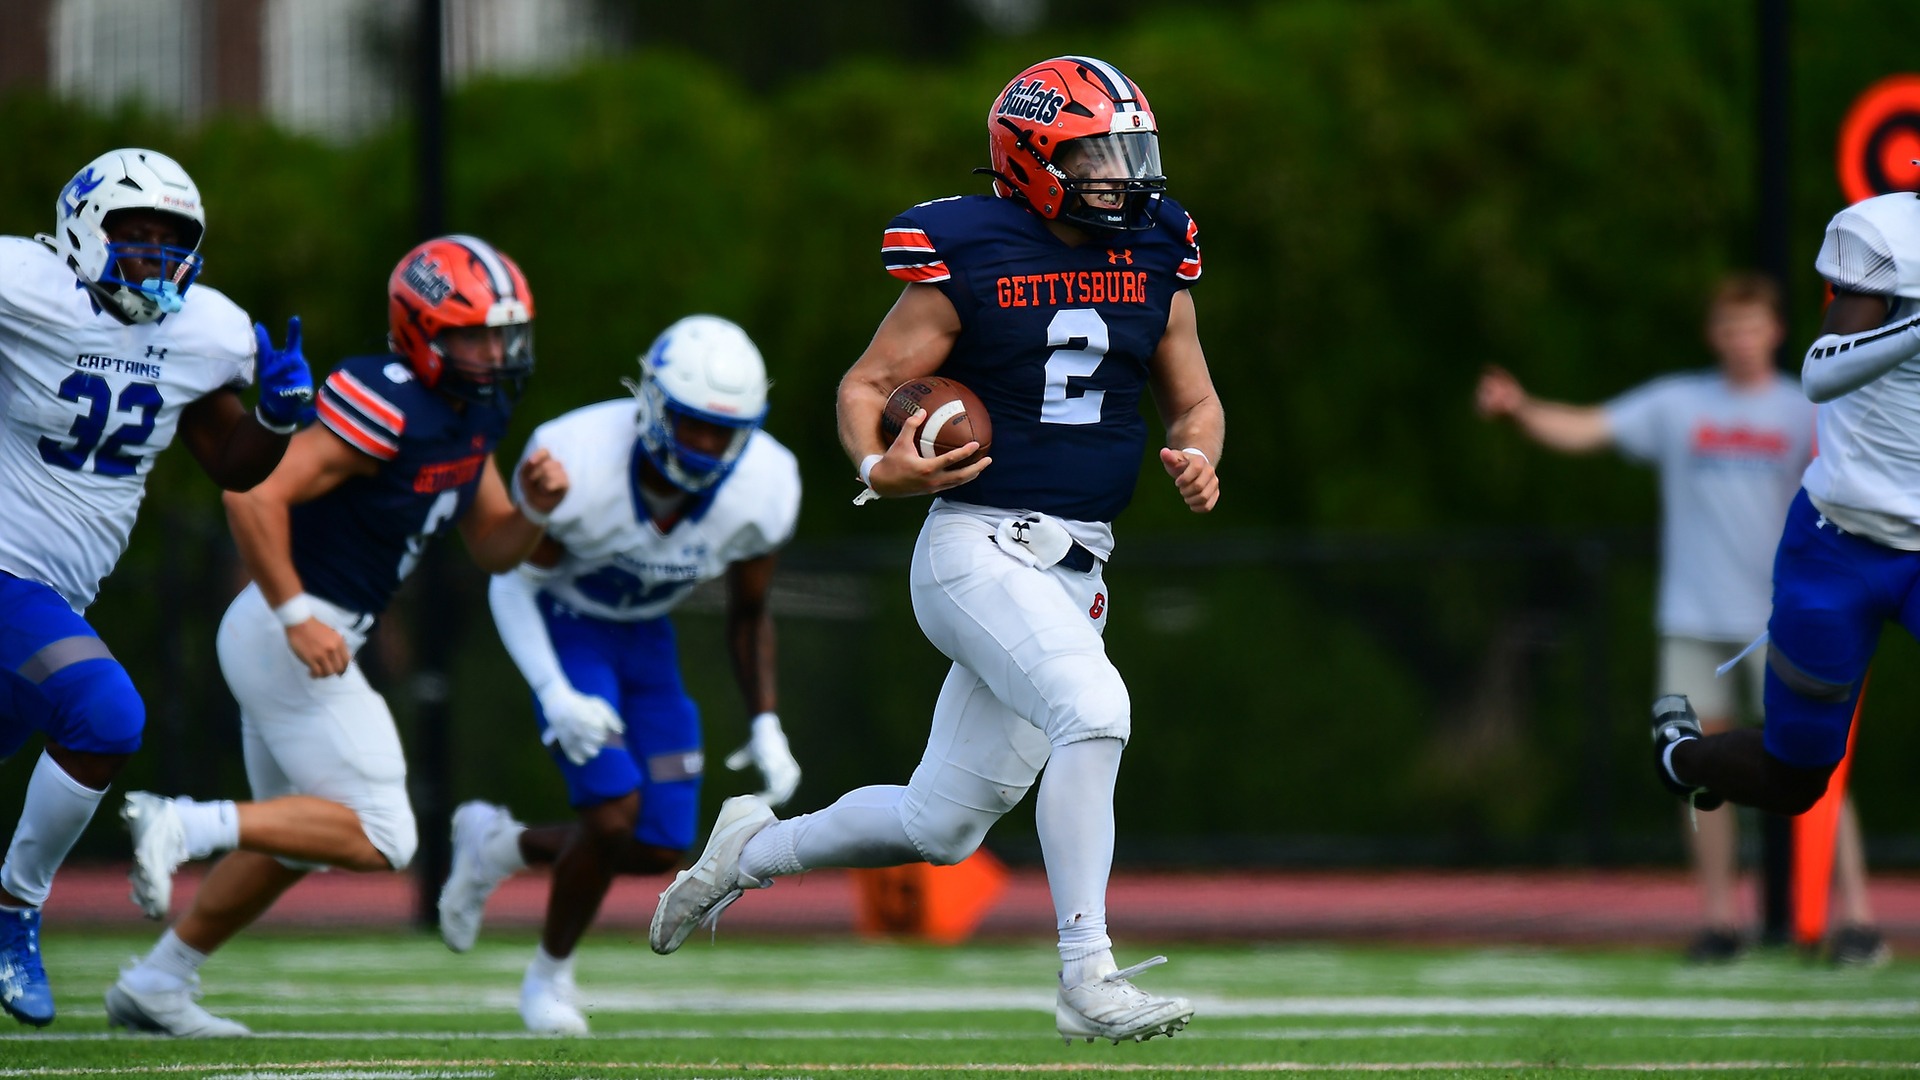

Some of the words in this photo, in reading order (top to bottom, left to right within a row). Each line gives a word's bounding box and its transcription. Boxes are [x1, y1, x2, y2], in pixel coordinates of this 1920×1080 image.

[996, 78, 1066, 126] Bullets
[1132, 115, 1141, 128] G
[996, 271, 1148, 308] GETTYSBURG
[76, 354, 161, 380] CAPTAINS
[1040, 308, 1110, 425] 2
[37, 370, 164, 477] 32
[1089, 592, 1106, 620] G
